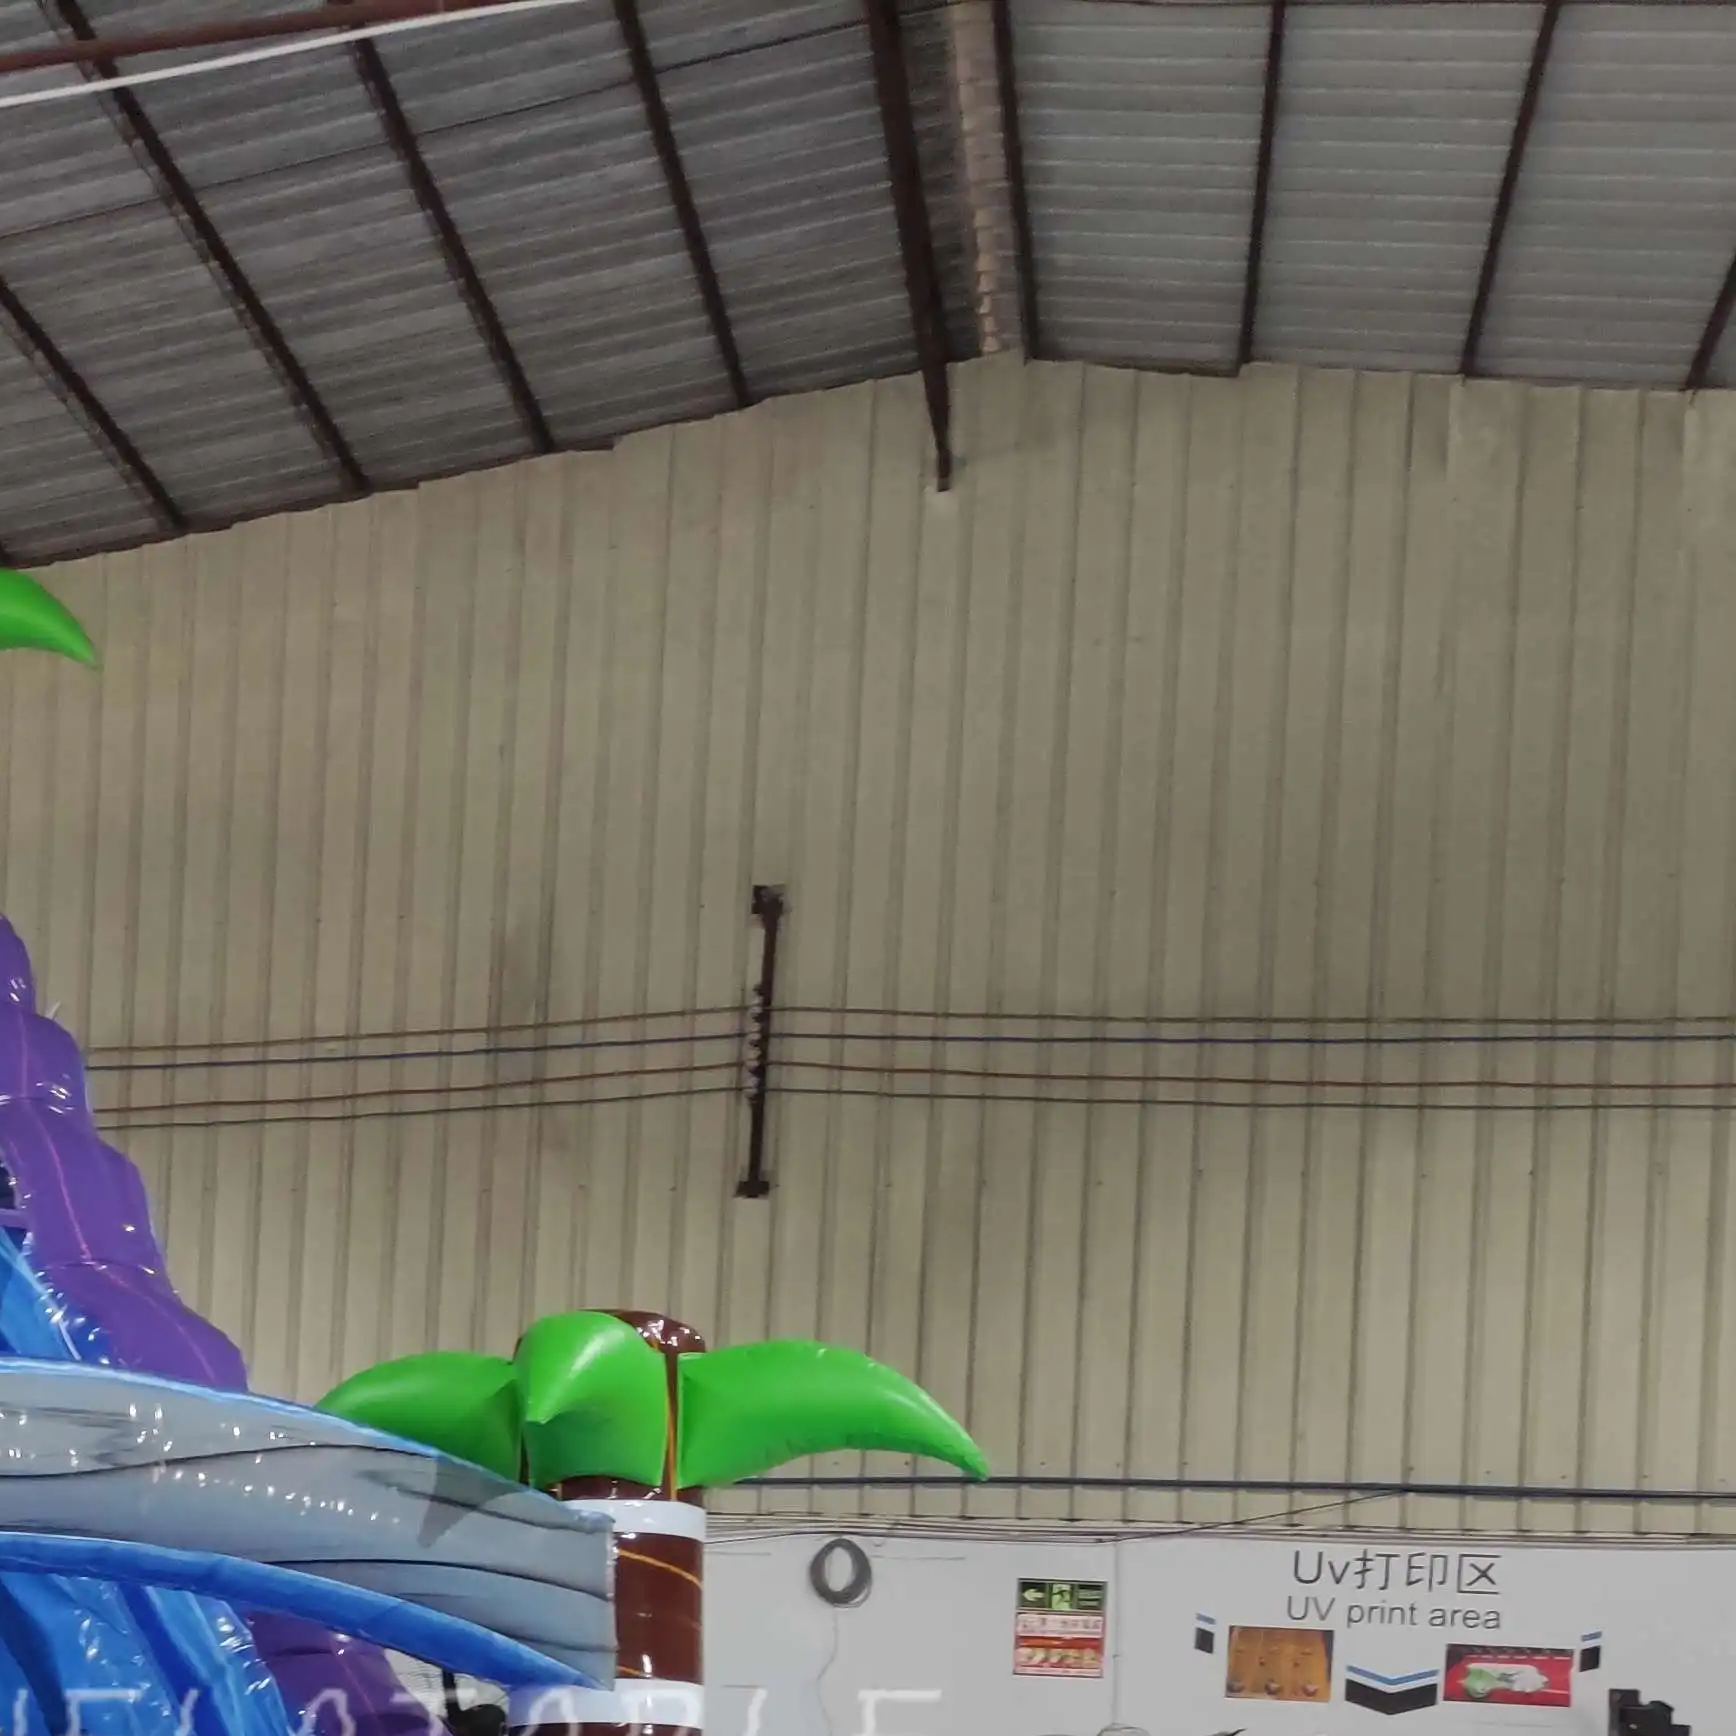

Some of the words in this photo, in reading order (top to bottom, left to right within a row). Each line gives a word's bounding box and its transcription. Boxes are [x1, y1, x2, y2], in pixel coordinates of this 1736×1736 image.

[1293, 1549, 1502, 1595] Uv打印区
[1286, 1596, 1336, 1622] UV
[1346, 1600, 1418, 1629] print
[1428, 1607, 1501, 1630] area
